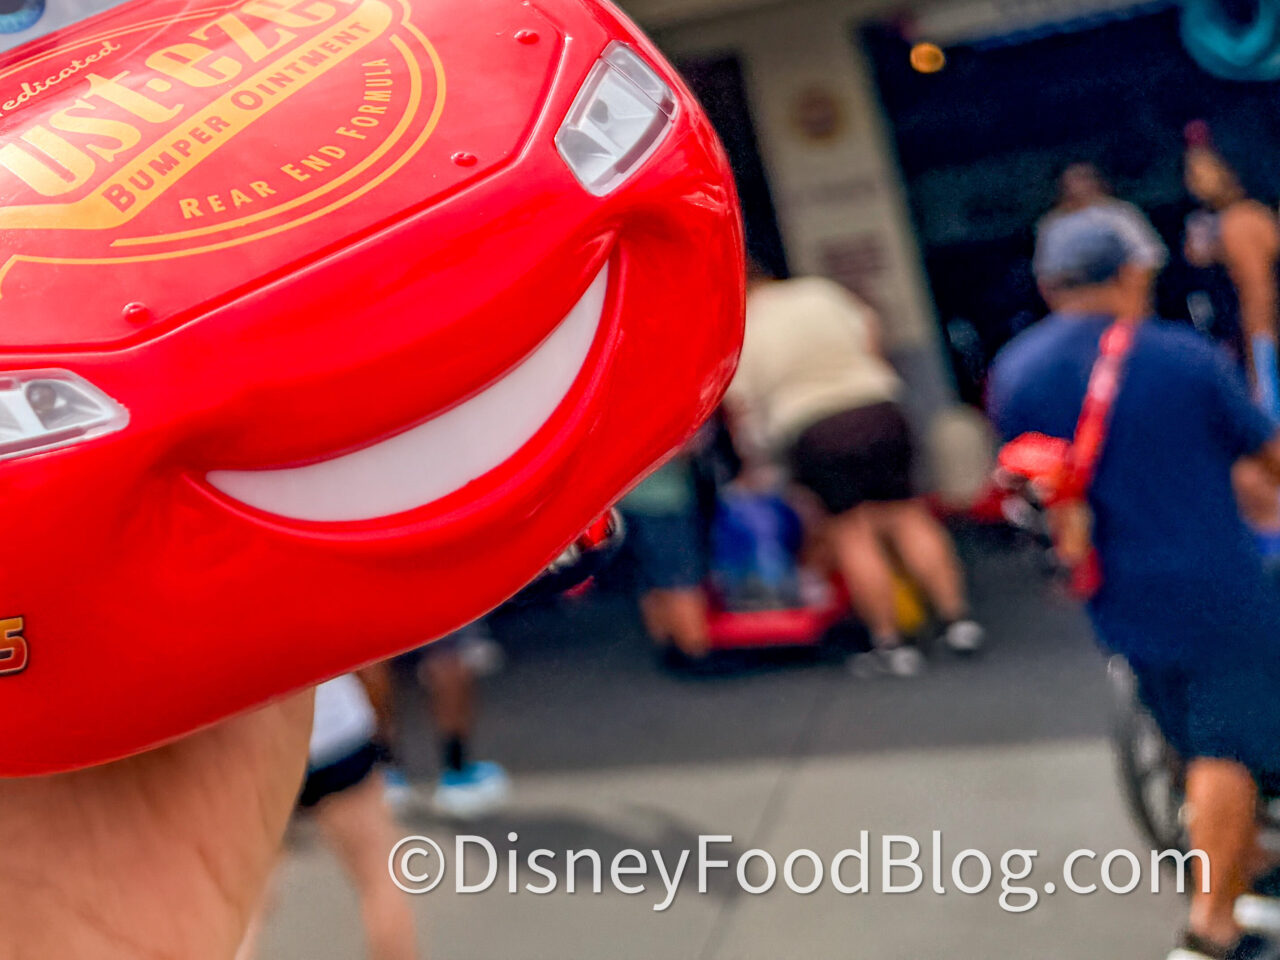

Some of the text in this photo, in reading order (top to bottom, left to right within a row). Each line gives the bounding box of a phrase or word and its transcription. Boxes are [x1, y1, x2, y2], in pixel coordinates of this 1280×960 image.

[101, 21, 371, 214] BUMPER OINTMENT
[178, 57, 395, 220] REAR END FORMULA
